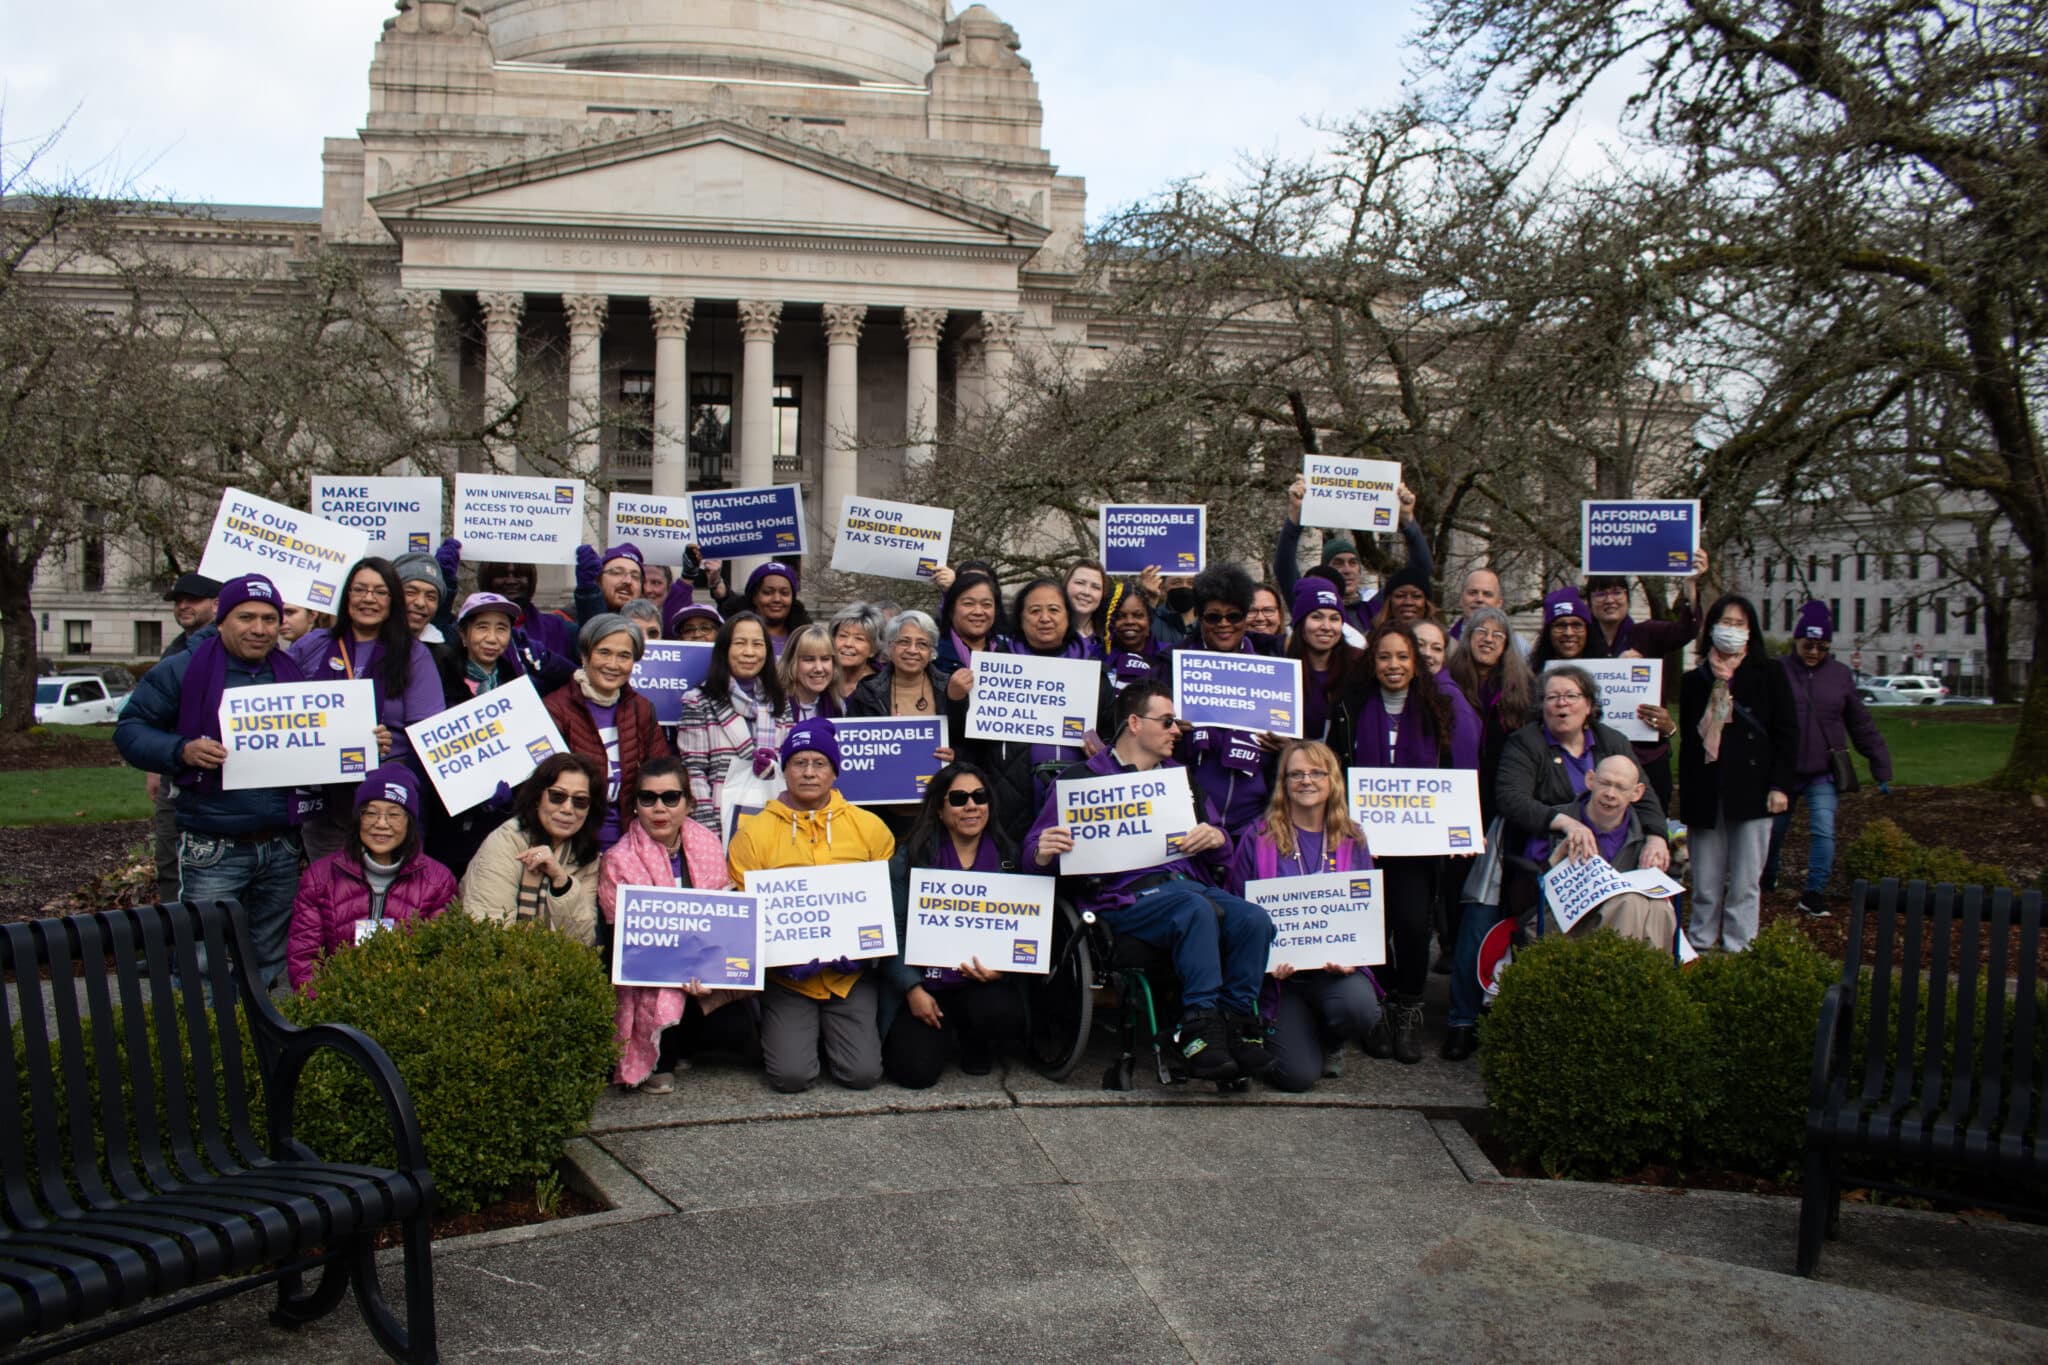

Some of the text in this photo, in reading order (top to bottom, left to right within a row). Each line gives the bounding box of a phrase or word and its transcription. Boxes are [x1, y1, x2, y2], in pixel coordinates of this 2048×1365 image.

[544, 248, 886, 277] LEGISLATIVE BUILDING
[1312, 464, 1359, 476] FIX OUR
[1311, 476, 1393, 490] UPSIDE DOWN
[322, 487, 369, 498] MAKE
[465, 488, 488, 498] WIN
[492, 490, 552, 500] UNIVERSAL
[1311, 488, 1379, 502] TAX SYSTEM
[322, 501, 420, 512] CAREGIVING
[464, 503, 571, 516] ACCESS TO QUALITY
[617, 502, 667, 515] FIX OUR
[694, 494, 777, 510] HEALTHCARE
[231, 502, 298, 534] FIX OUR
[338, 516, 386, 526] GOOD
[616, 514, 690, 528] UPSIDE DO
[696, 512, 722, 522] FOR
[850, 506, 903, 522] FIX OUR
[1108, 514, 1195, 524] AFFORDABLE
[1591, 510, 1688, 520] AFFORDABLE
[464, 516, 533, 528] HEALTH AND
[698, 516, 795, 534] NURSING HOME
[848, 518, 942, 540] UPSIDE DOWN
[1591, 523, 1657, 534] HOUSING
[464, 530, 558, 542] LONG-TERM CARE
[616, 526, 690, 541] TAX SYSTEM
[1108, 526, 1168, 536] HOUSING
[226, 517, 346, 563] UPSIDE DOWN
[698, 531, 763, 548] WORKERS
[846, 530, 925, 551] TAX SYSTEM
[1108, 538, 1145, 548] NOW!
[1591, 536, 1632, 546] NOW!
[223, 531, 322, 573] TAX SYSTEM
[980, 662, 1023, 674] BUILD
[1182, 658, 1276, 674] HEALTHCARE
[1183, 670, 1212, 680] FOR
[1592, 672, 1629, 680] ERSAL
[628, 678, 689, 690] ACARES
[978, 676, 1065, 692] POWER FOR
[1604, 685, 1648, 694] QUALITY
[978, 690, 1066, 706] CAREGIVERS
[1183, 682, 1292, 702] NURSING HOME
[230, 693, 345, 714] FIGHT FOR
[1183, 695, 1256, 710] WORKERS
[976, 705, 1038, 720] AND ALL
[1607, 712, 1634, 720] CARE
[232, 713, 320, 732] JUSTICE
[420, 698, 512, 748] FIGHT FOR
[976, 720, 1055, 737] WORKERS
[235, 732, 326, 750] FOR ALL
[428, 722, 500, 764] JUSTICE
[840, 744, 902, 756] OUSING
[1228, 748, 1256, 760] SEIU
[438, 754, 474, 780] FOR
[478, 738, 511, 762] ALL
[840, 758, 875, 770] OW!
[1358, 778, 1452, 792] FIGHT FOR
[1068, 782, 1166, 806] FIGHT FOR
[1358, 794, 1430, 808] JUSTICE
[1068, 802, 1148, 823] JUSTICE
[1360, 810, 1436, 824] FOR ALL
[1070, 820, 1152, 840] FOR ALL
[756, 879, 808, 894] MAKE
[920, 882, 988, 897] FIX OUR
[1560, 864, 1614, 903] CAREGIV
[1256, 894, 1279, 904] WIN
[1282, 888, 1346, 902] UNIVERSAL
[1564, 874, 1618, 913] AND ALL
[1566, 880, 1632, 921] WORKER
[626, 899, 750, 918] AFFORDABLE
[920, 897, 1040, 916] UPSIDE DOWN
[1267, 902, 1370, 918] CESS TO QUALITY
[626, 916, 711, 932] HOUSING
[777, 910, 830, 925] GOOD
[918, 914, 1018, 932] TAX SYSTEM
[1279, 920, 1328, 932] LTH AND
[625, 932, 680, 948] NOW!
[1270, 933, 1357, 948] NG-TERM CARE
